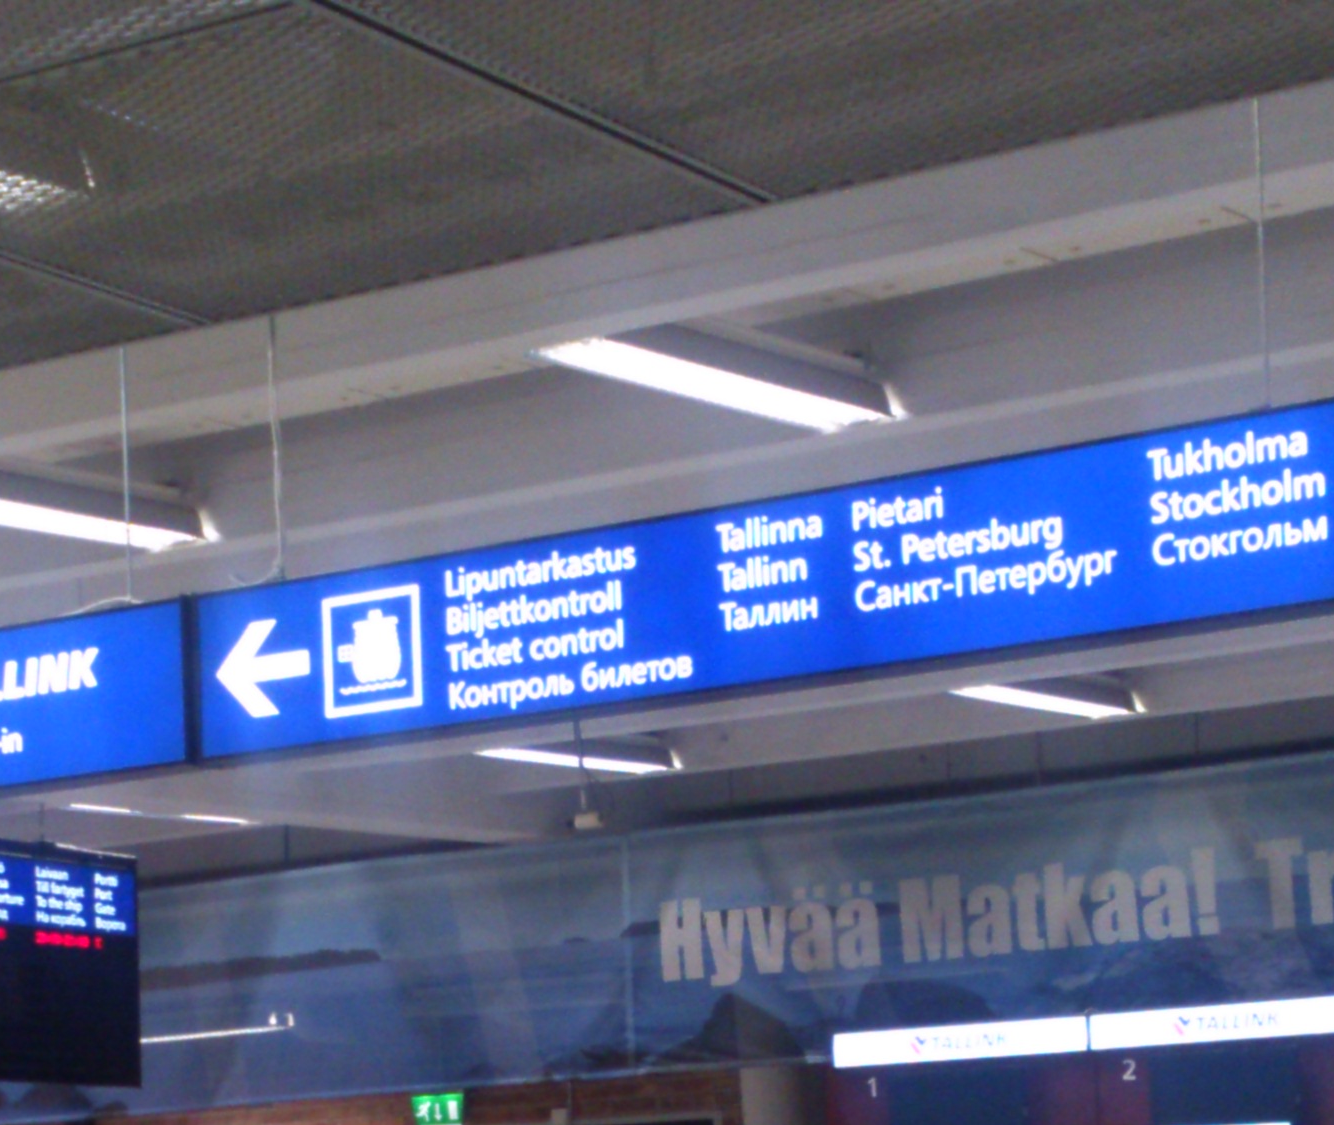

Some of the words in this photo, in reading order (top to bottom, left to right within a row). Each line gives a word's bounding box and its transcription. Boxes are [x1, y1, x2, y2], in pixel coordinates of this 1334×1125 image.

[1147, 430, 1309, 480] Tukholma
[851, 486, 944, 532] Pietari
[1149, 467, 1326, 525] Stockholm
[715, 513, 823, 554] Tallinna
[853, 540, 895, 572] St.
[900, 514, 1064, 566] Petersburg
[1152, 515, 1328, 566] Стокгольм
[444, 544, 637, 600] Lipuntarkastus
[716, 555, 808, 593] Tallinn
[855, 549, 1118, 612] Санкт-Петербург
[445, 580, 623, 638] Biljettkontroll
[718, 596, 818, 632] Таллин
[446, 635, 524, 673] Ticket
[528, 617, 624, 661] control
[447, 669, 575, 710] Контроль
[580, 654, 693, 693] билетов
[94, 901, 116, 916] Gate
[659, 880, 882, 987] Hyvää
[897, 847, 1220, 964] Matkaa!
[931, 1033, 1006, 1050] TALLINK
[1196, 1012, 1277, 1031] TALLINK
[867, 1077, 878, 1098] 1
[1121, 1059, 1137, 1081] 2
